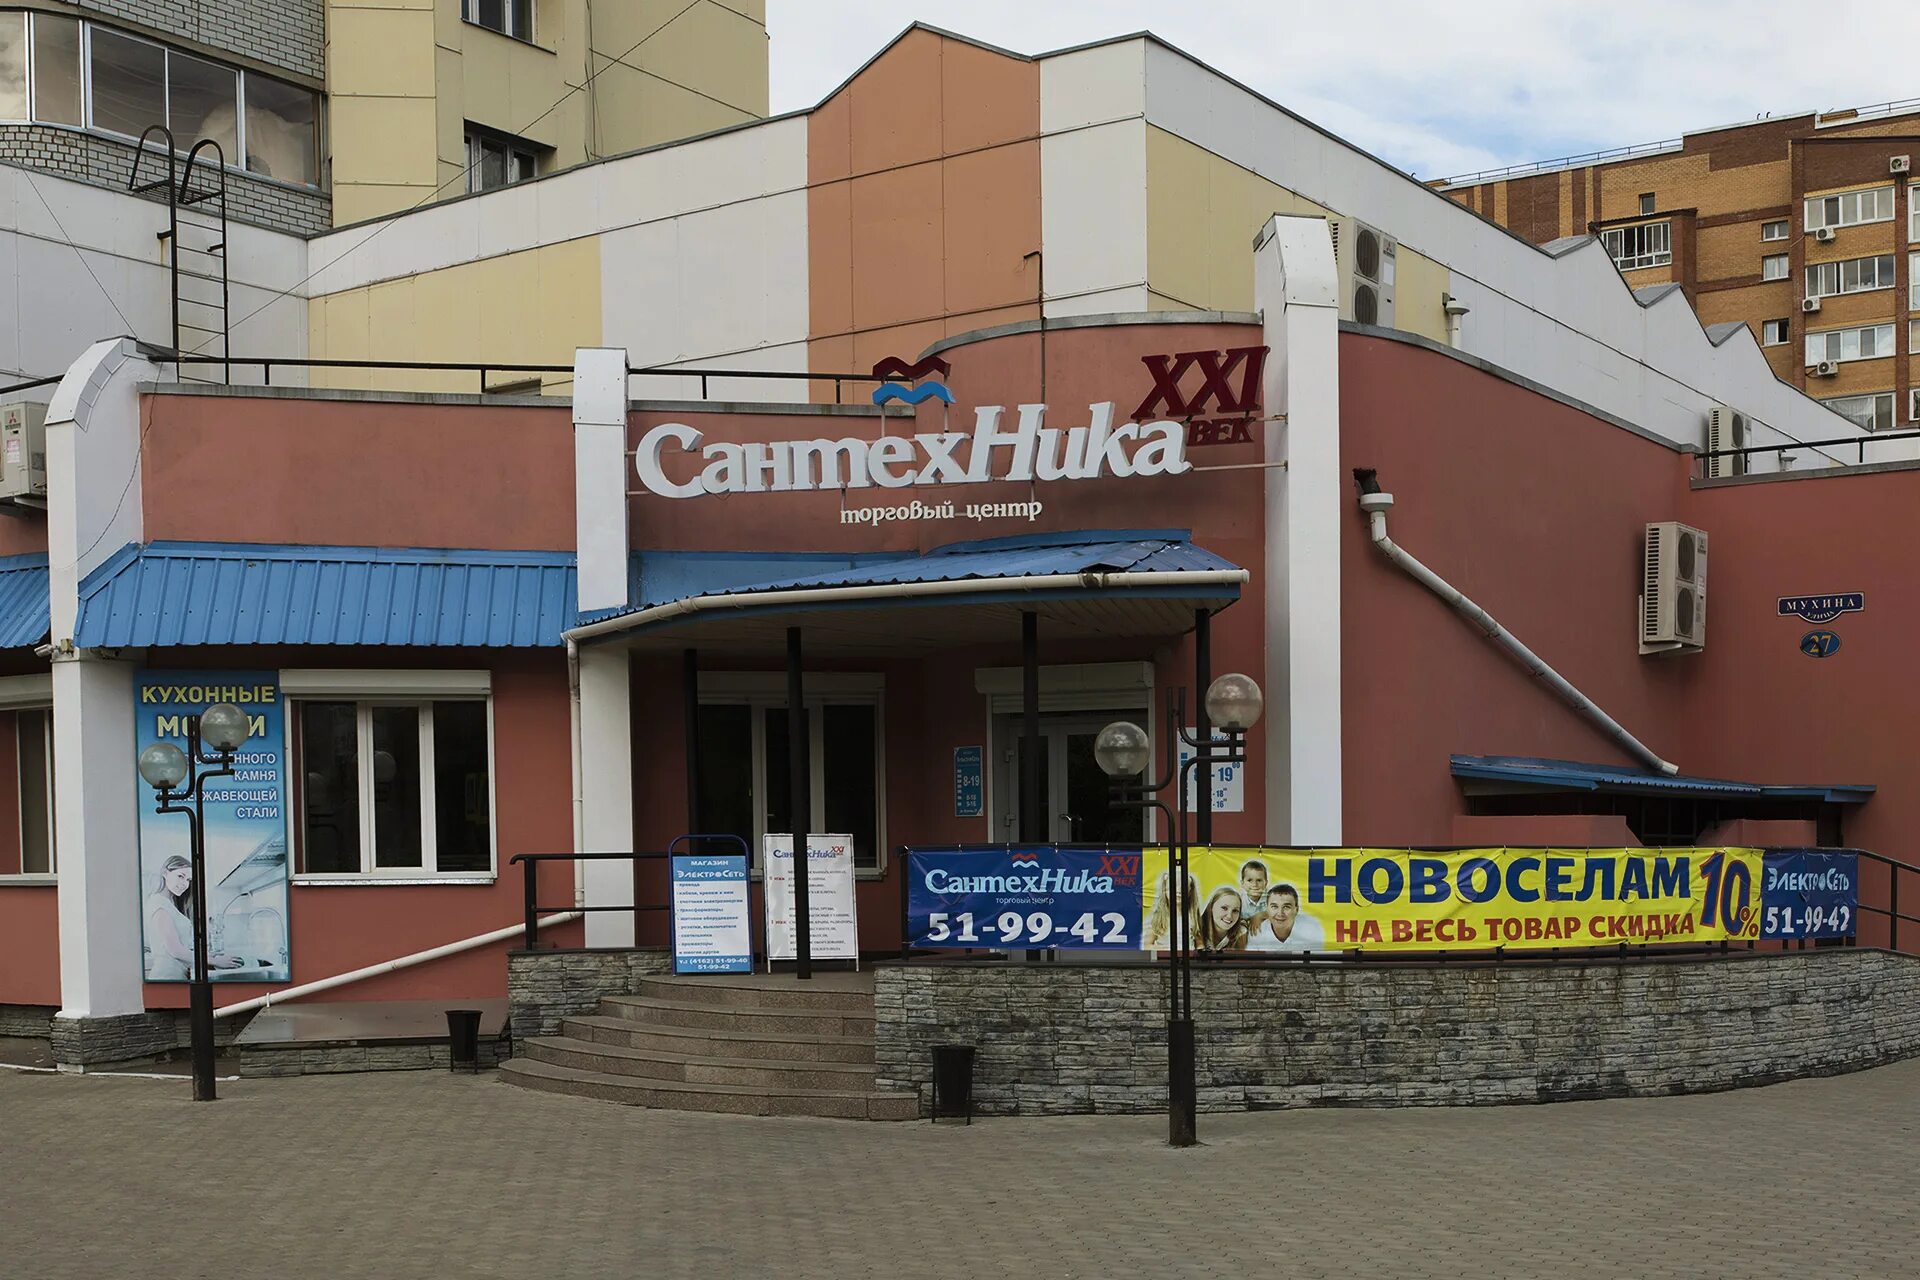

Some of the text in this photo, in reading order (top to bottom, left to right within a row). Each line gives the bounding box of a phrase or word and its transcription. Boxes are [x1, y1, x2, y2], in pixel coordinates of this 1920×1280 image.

[1131, 345, 1270, 420] XXI
[1186, 417, 1256, 447] ВЕК
[635, 401, 1192, 498] СантехНика
[840, 499, 1043, 526] торговый центр
[1786, 598, 1855, 611] МУХИНА
[1810, 634, 1832, 653] 27
[142, 686, 275, 704] КУХОННЫЕ
[234, 770, 276, 781] КАМНЯ
[237, 807, 278, 818] СТАЛИ
[1096, 855, 1140, 877] XXI
[925, 868, 1114, 894] СантехНика
[1307, 857, 1691, 904] НОВОСЕЛАМ
[995, 895, 1031, 905] торговый
[1699, 851, 1759, 938] 10%
[927, 911, 1128, 943] 51-99-42
[1336, 913, 1694, 943] НА ВЕСЬ ТОВАР СКИДКА
[1764, 905, 1850, 934] 51-99-42
